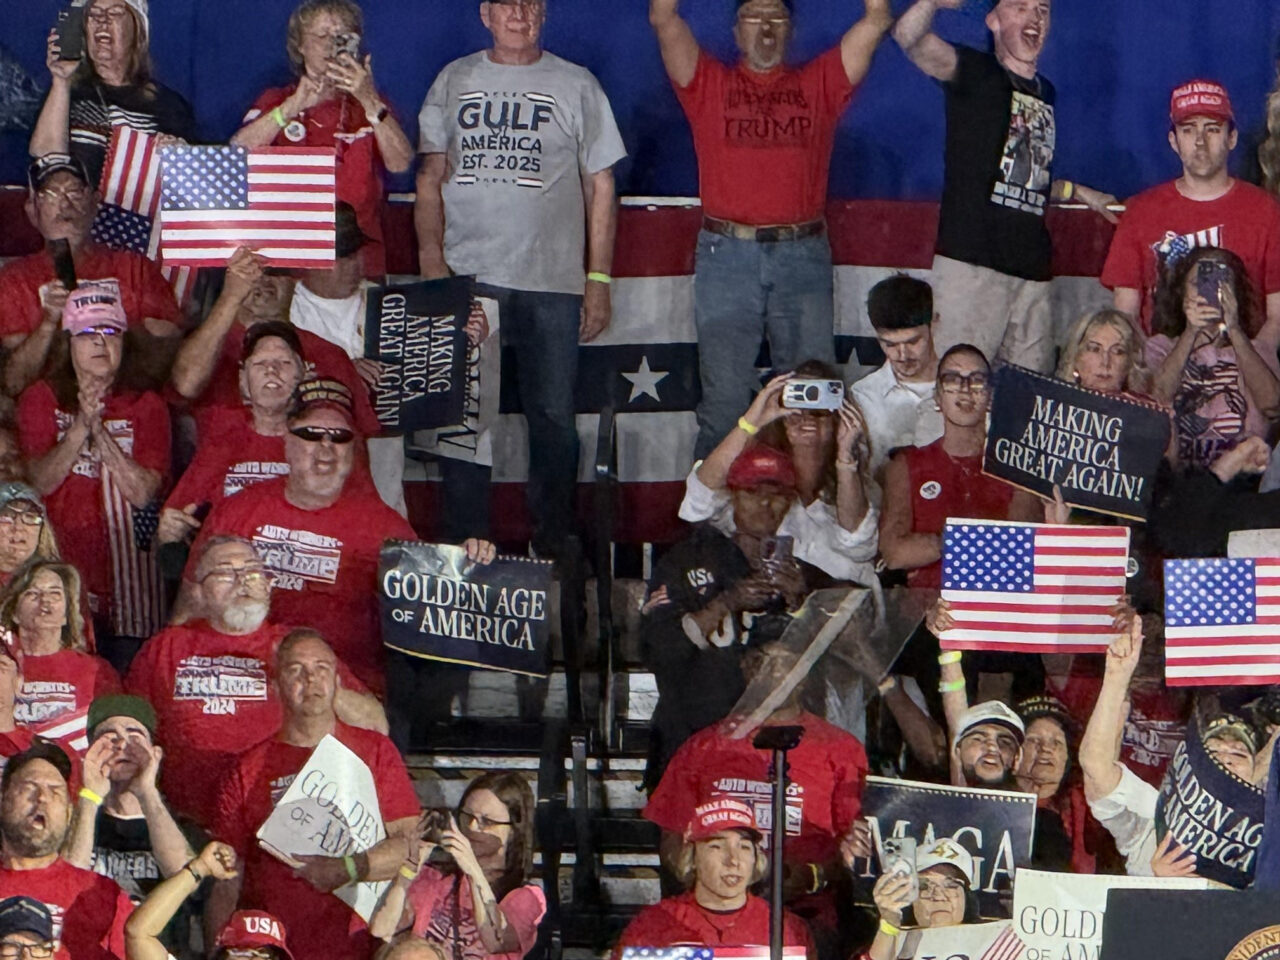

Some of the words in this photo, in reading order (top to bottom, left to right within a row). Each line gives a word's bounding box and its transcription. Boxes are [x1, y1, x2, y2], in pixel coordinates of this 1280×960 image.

[458, 101, 552, 131] GULF
[724, 115, 812, 138] TRUMP
[462, 135, 542, 154] AMERICA
[462, 153, 488, 169] EST.
[493, 154, 541, 172] 2025
[379, 293, 407, 358] GREAT
[402, 314, 430, 401] AMERICA
[428, 315, 455, 393] MAKING
[1031, 395, 1123, 443] MAKING
[1020, 422, 1120, 471] AMERICA
[995, 438, 1063, 484] GREAT
[1062, 463, 1144, 502] AGAIN!
[384, 569, 489, 613] GOLDEN
[494, 587, 546, 620] AGE
[392, 608, 415, 623] OF
[419, 606, 535, 651] AMERICA
[203, 699, 236, 715] 2024
[290, 806, 314, 826] OF
[859, 815, 1016, 893] MGA
[245, 916, 281, 938] USA
